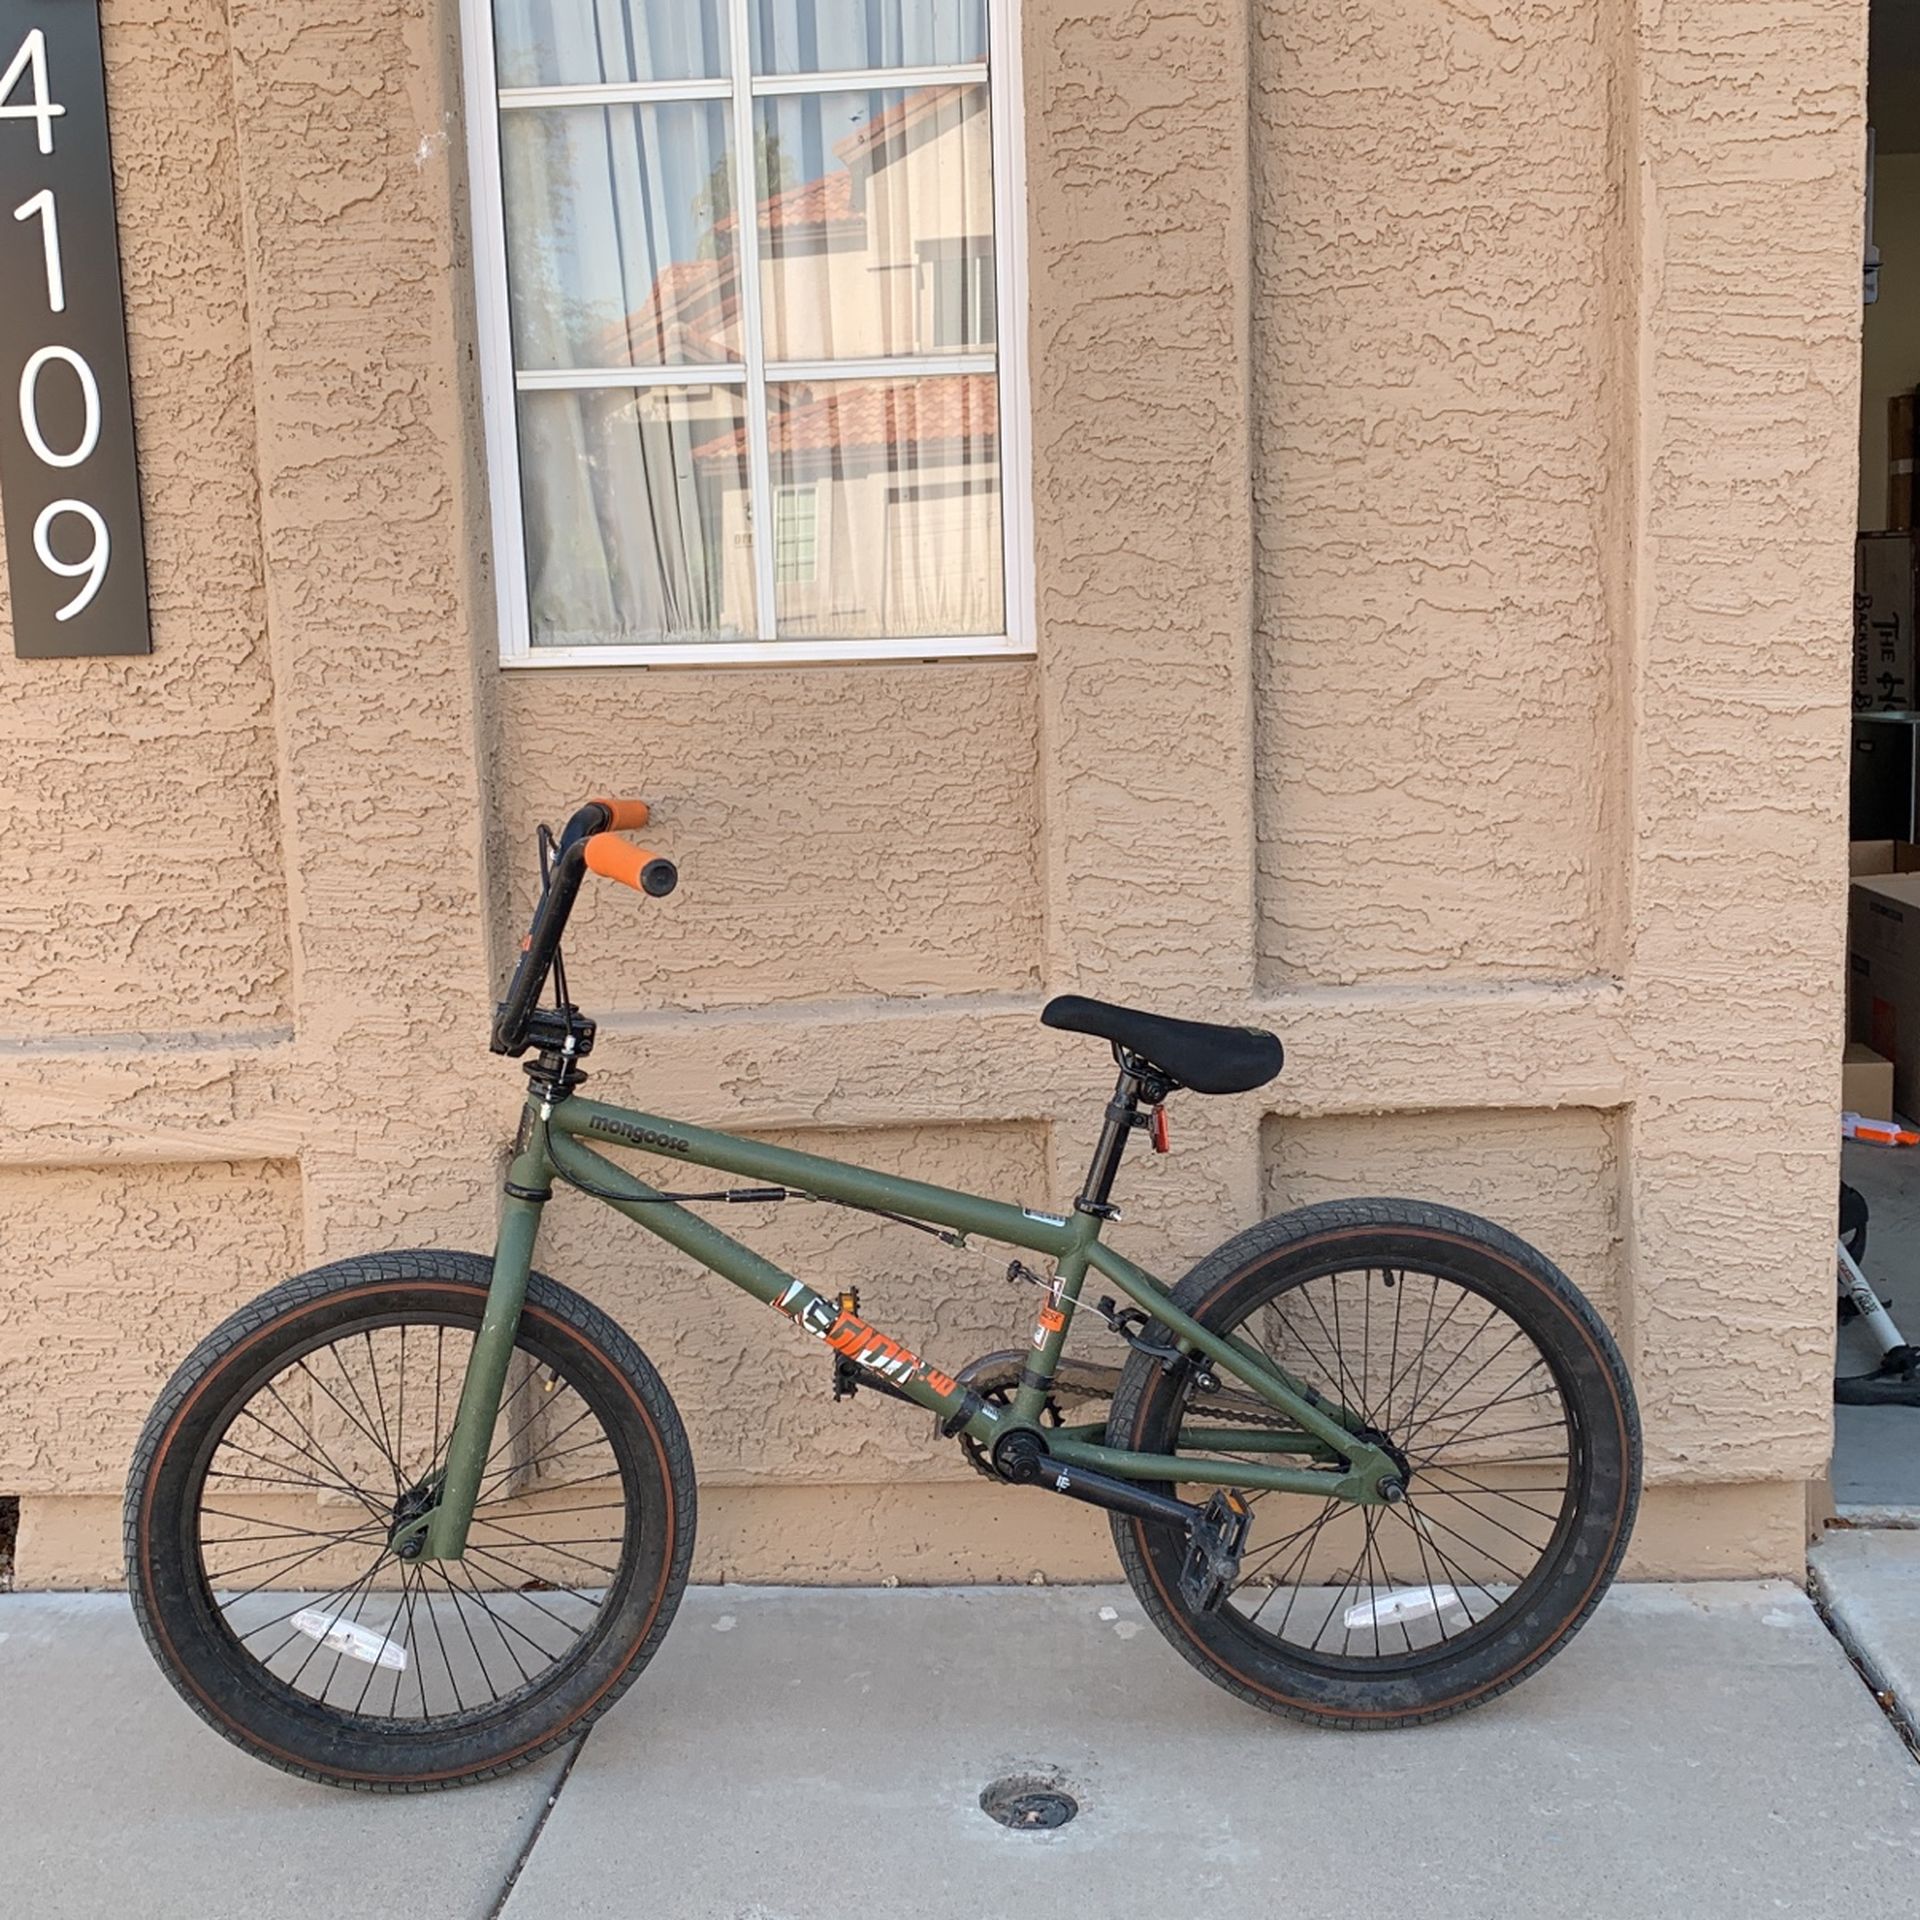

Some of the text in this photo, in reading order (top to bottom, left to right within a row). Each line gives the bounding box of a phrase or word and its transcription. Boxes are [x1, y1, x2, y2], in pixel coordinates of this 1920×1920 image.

[0, 28, 112, 622] 4109
[1855, 591, 1873, 685] BACKYARD
[1871, 611, 1900, 662] THE
[588, 1114, 690, 1153] mongoose
